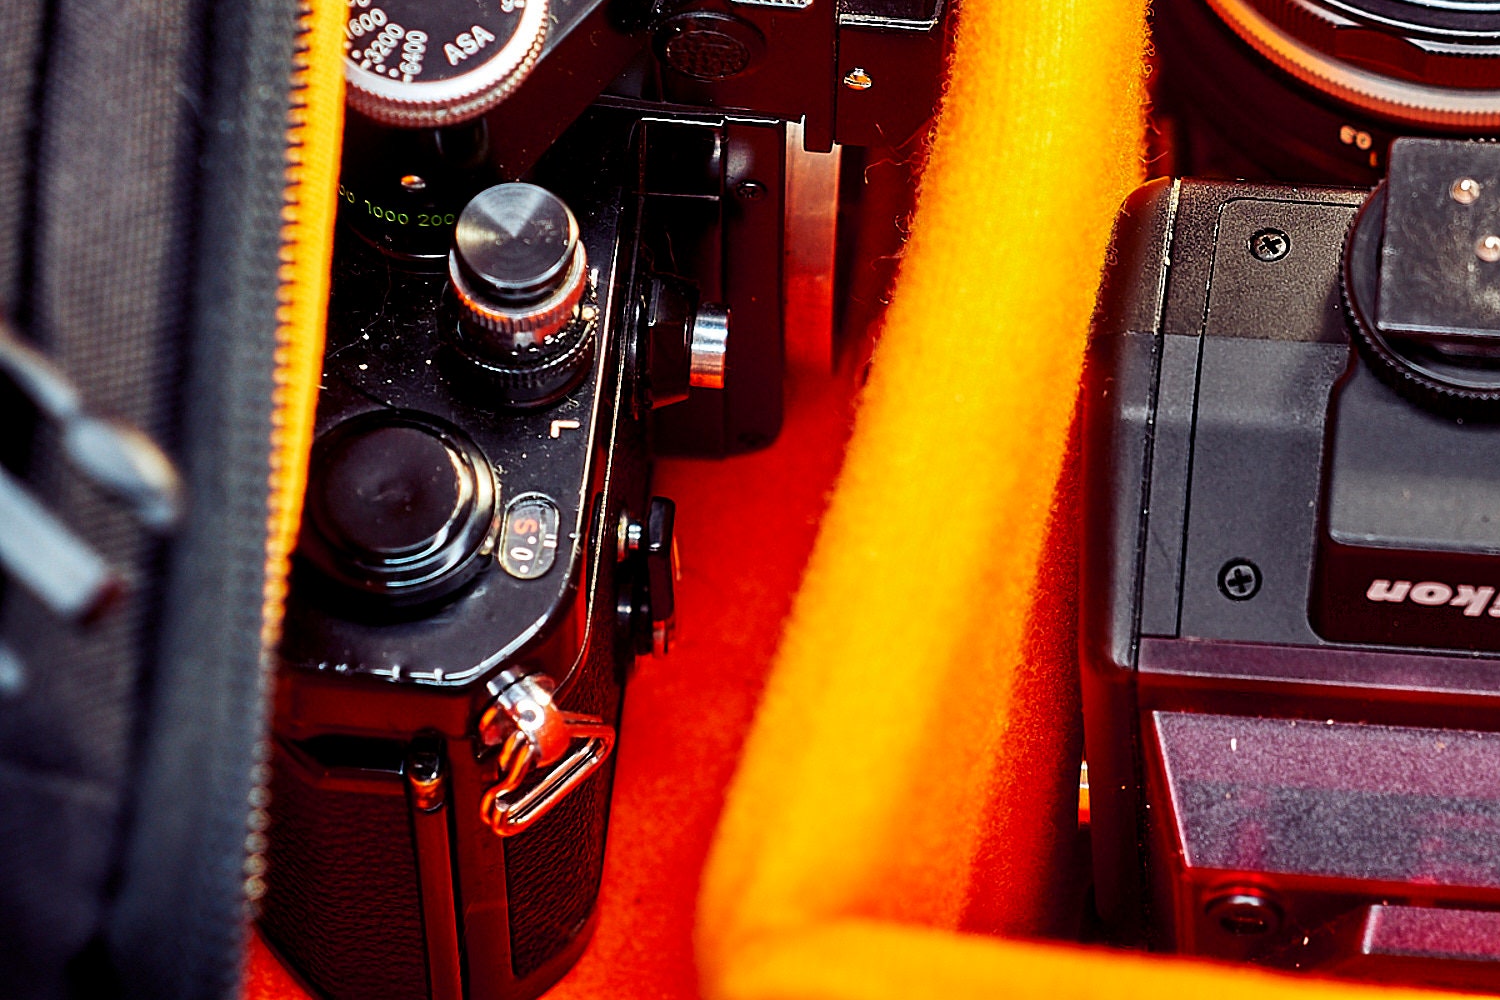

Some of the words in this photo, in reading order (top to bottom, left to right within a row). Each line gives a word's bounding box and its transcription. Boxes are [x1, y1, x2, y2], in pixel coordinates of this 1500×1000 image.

[364, 23, 405, 64] 3200
[399, 30, 428, 75] 6400
[444, 25, 496, 66] ASA
[364, 199, 408, 225] 1000
[549, 419, 581, 439] L
[514, 518, 538, 535] S
